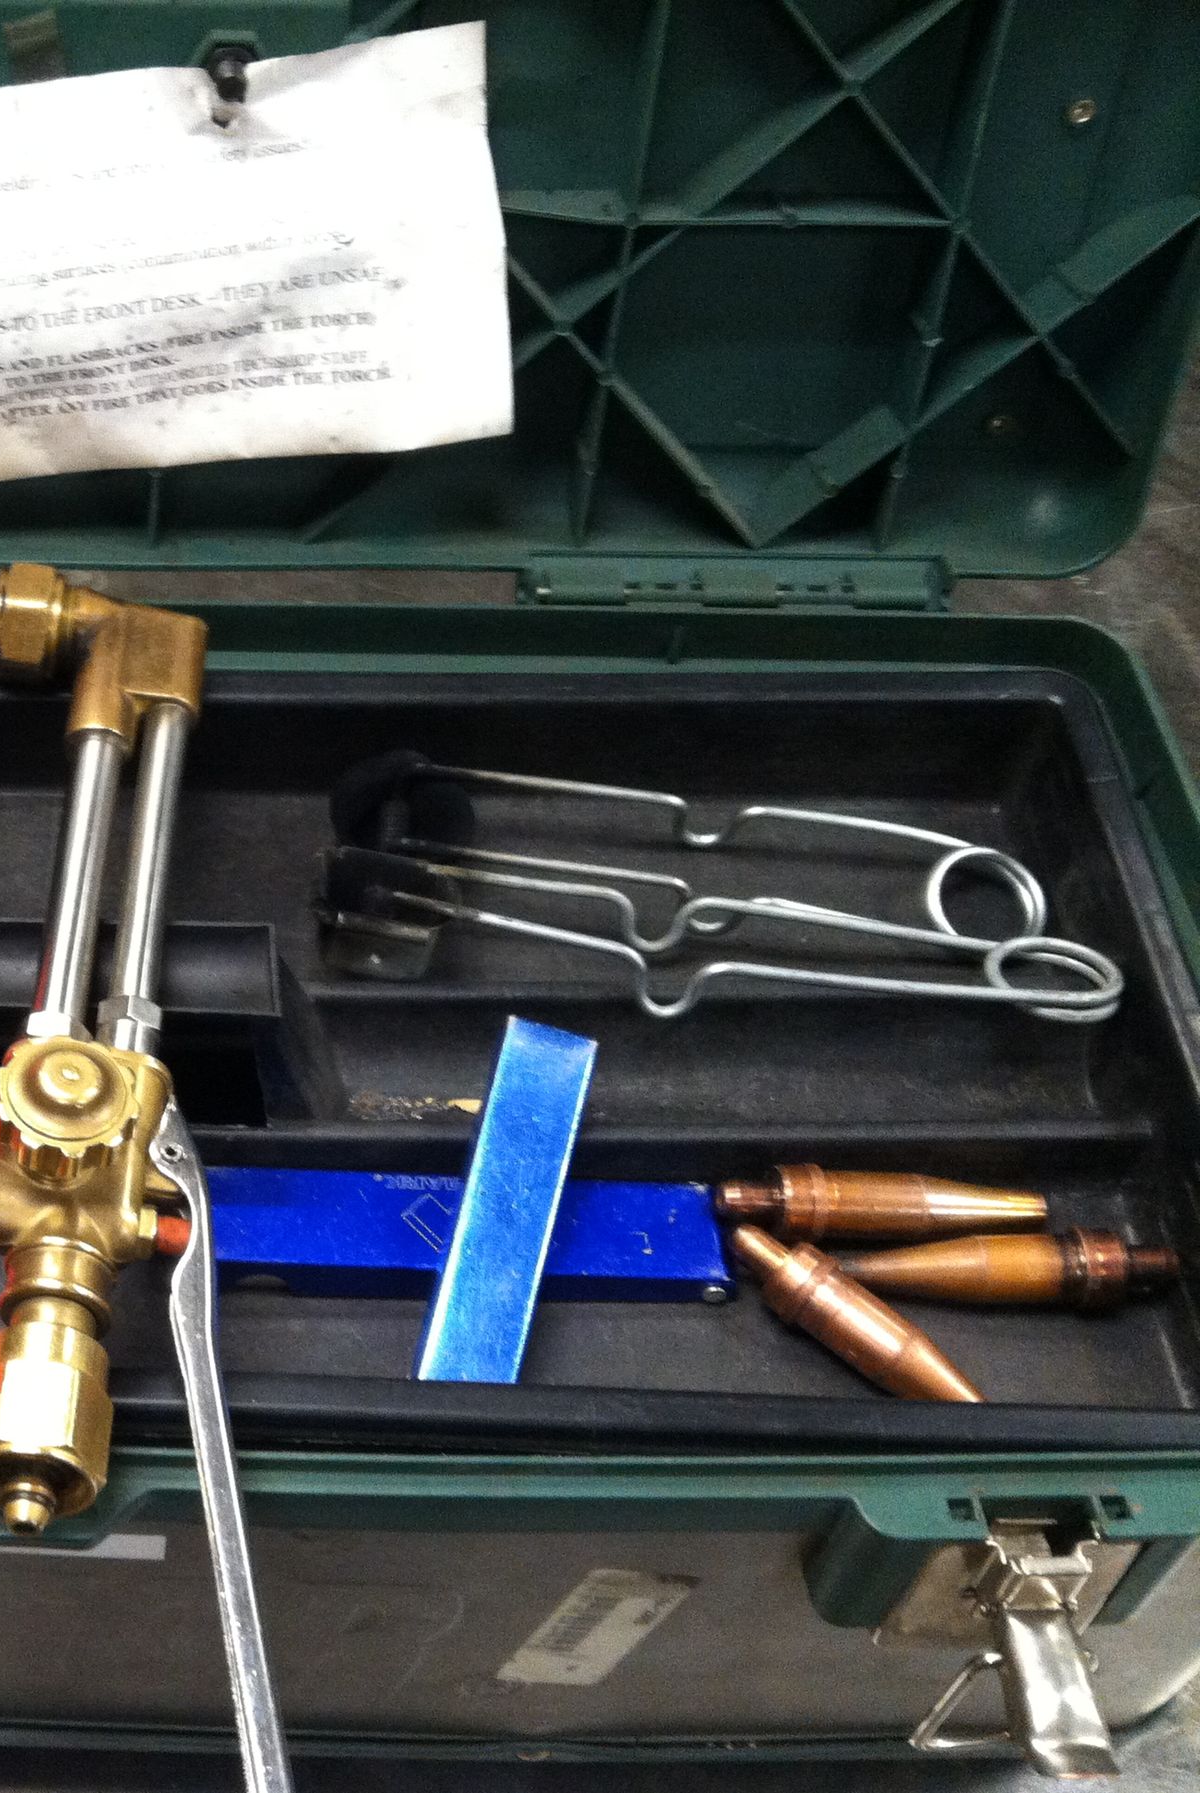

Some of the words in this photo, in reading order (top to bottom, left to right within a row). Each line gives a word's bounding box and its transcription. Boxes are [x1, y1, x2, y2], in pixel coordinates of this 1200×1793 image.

[40, 308, 77, 329] THE
[83, 300, 148, 324] FRONT
[150, 292, 204, 315] DESK
[220, 280, 272, 303] THEY
[276, 272, 317, 294] ARE
